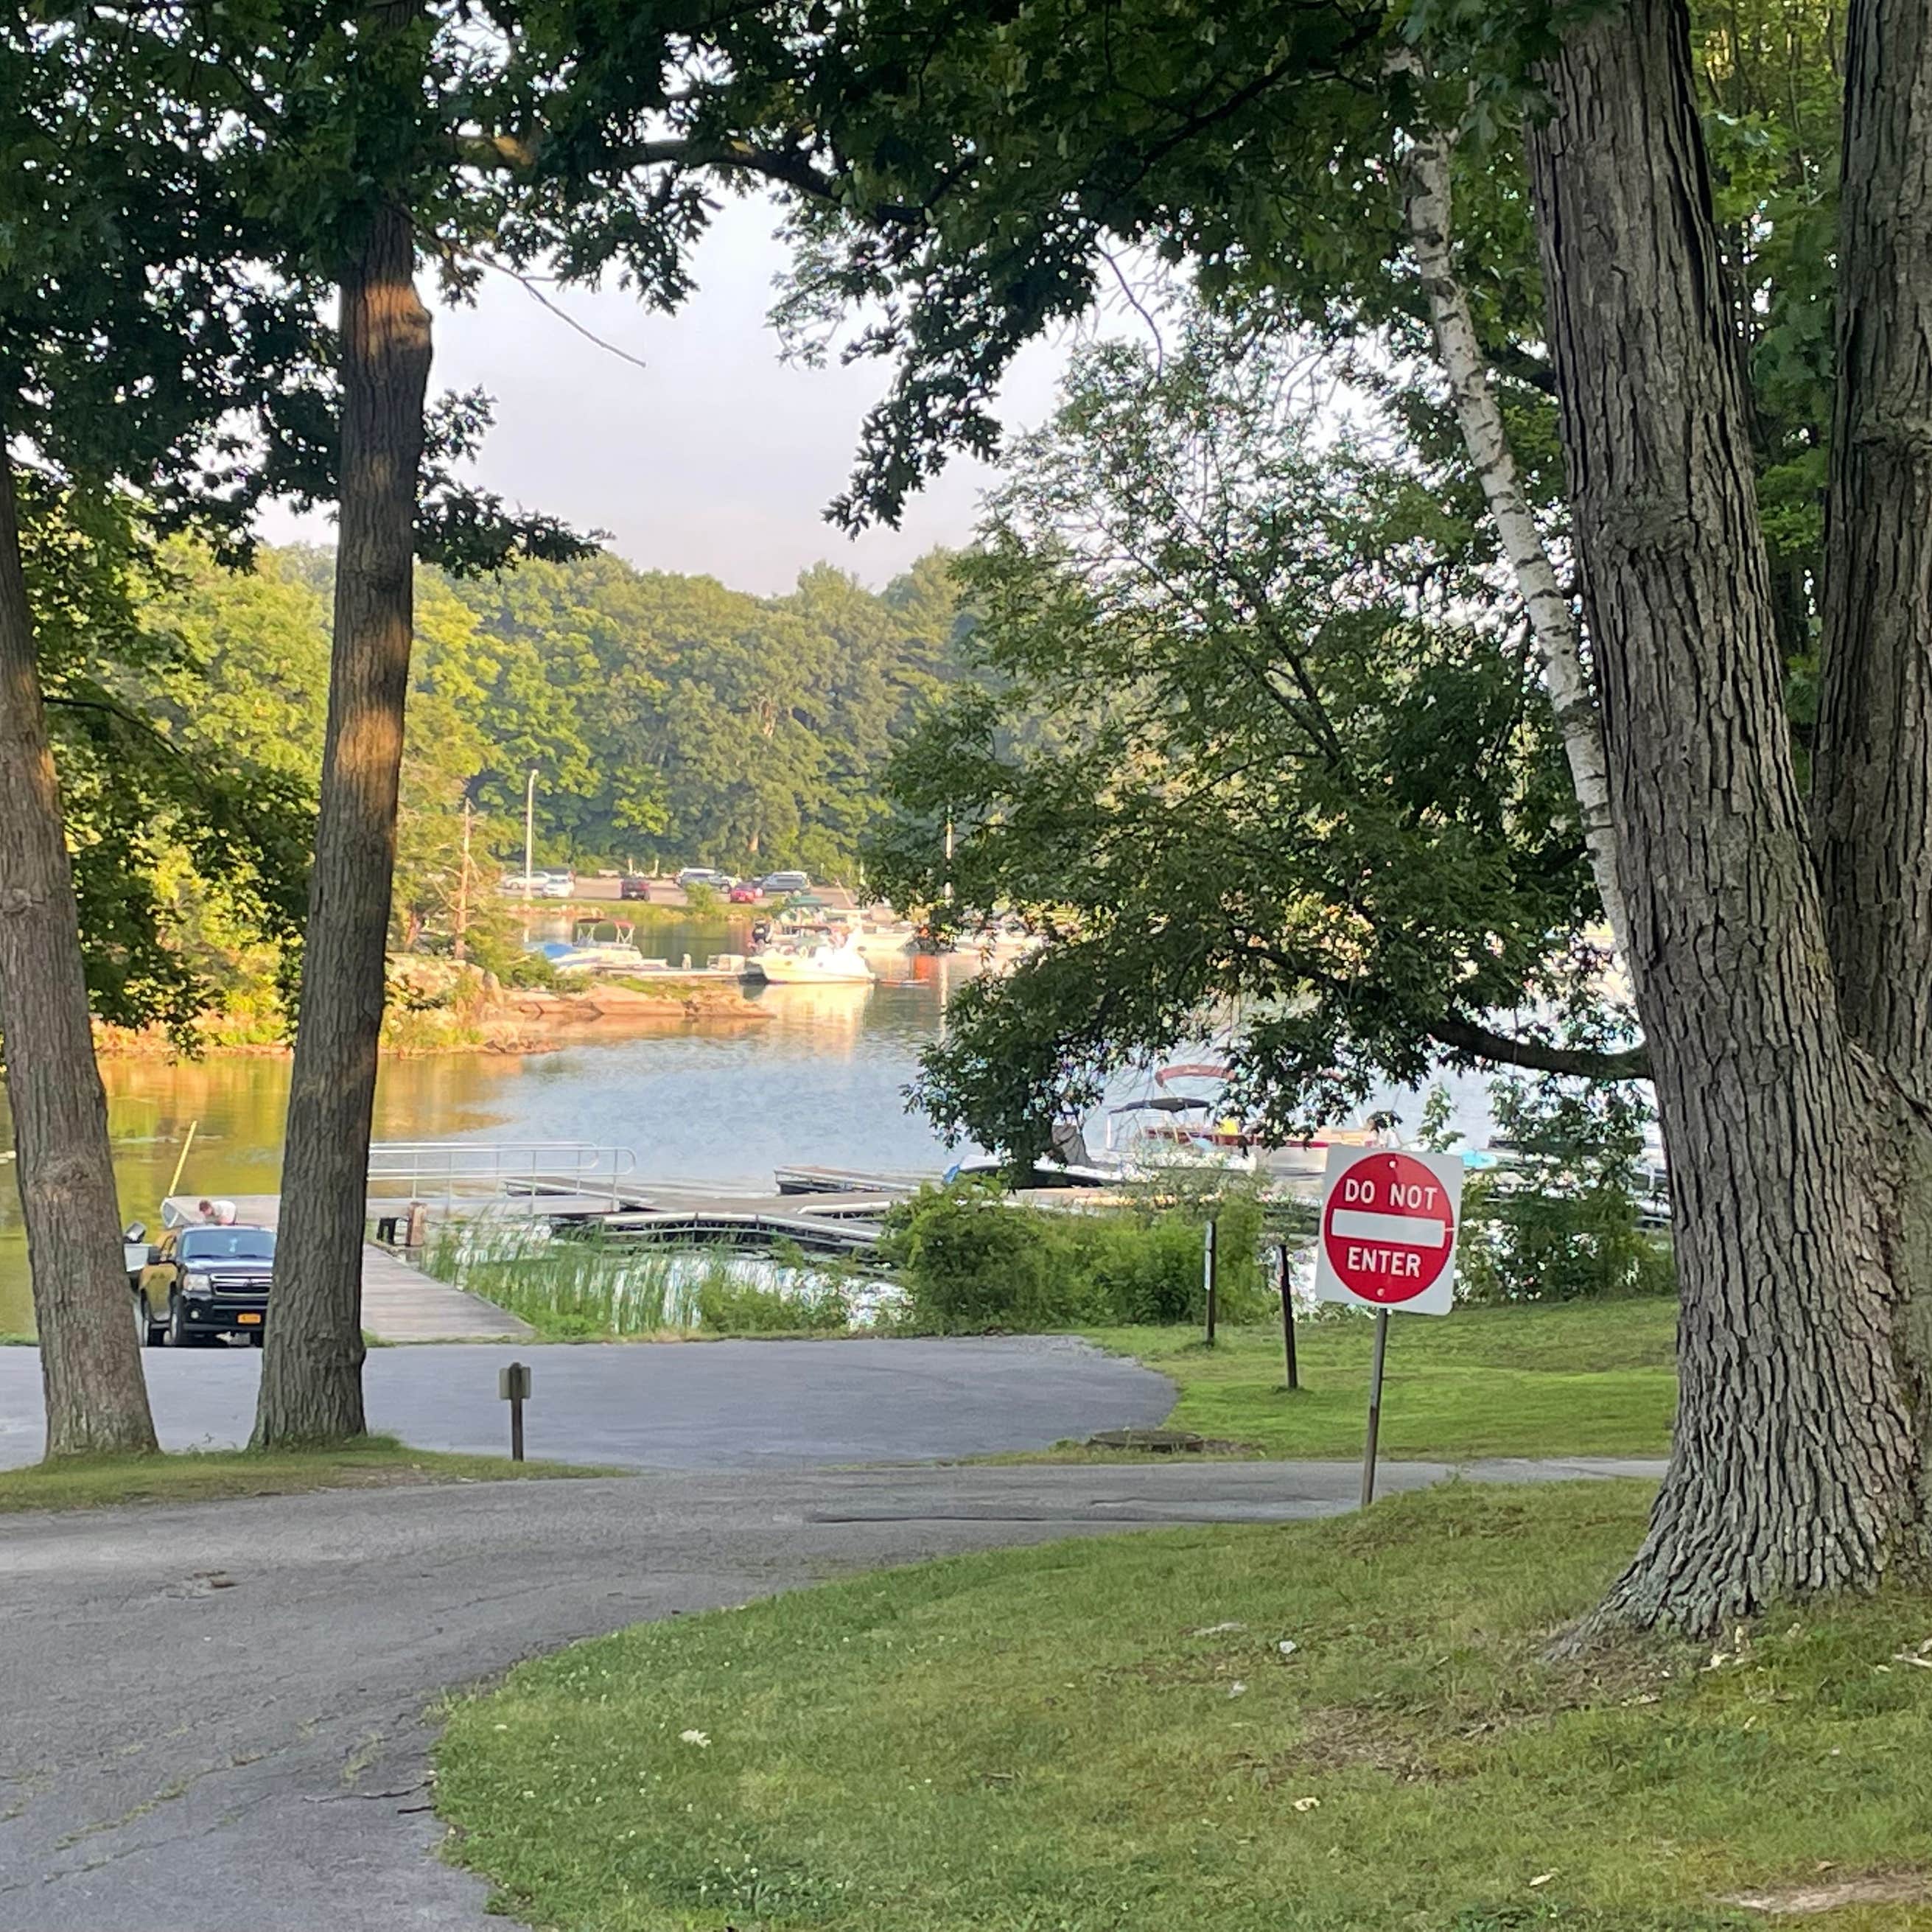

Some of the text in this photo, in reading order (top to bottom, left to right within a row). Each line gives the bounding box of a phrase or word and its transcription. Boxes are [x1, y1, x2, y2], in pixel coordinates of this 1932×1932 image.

[1345, 1178, 1438, 1210] DO NOT
[1348, 1247, 1421, 1278] ENTER
